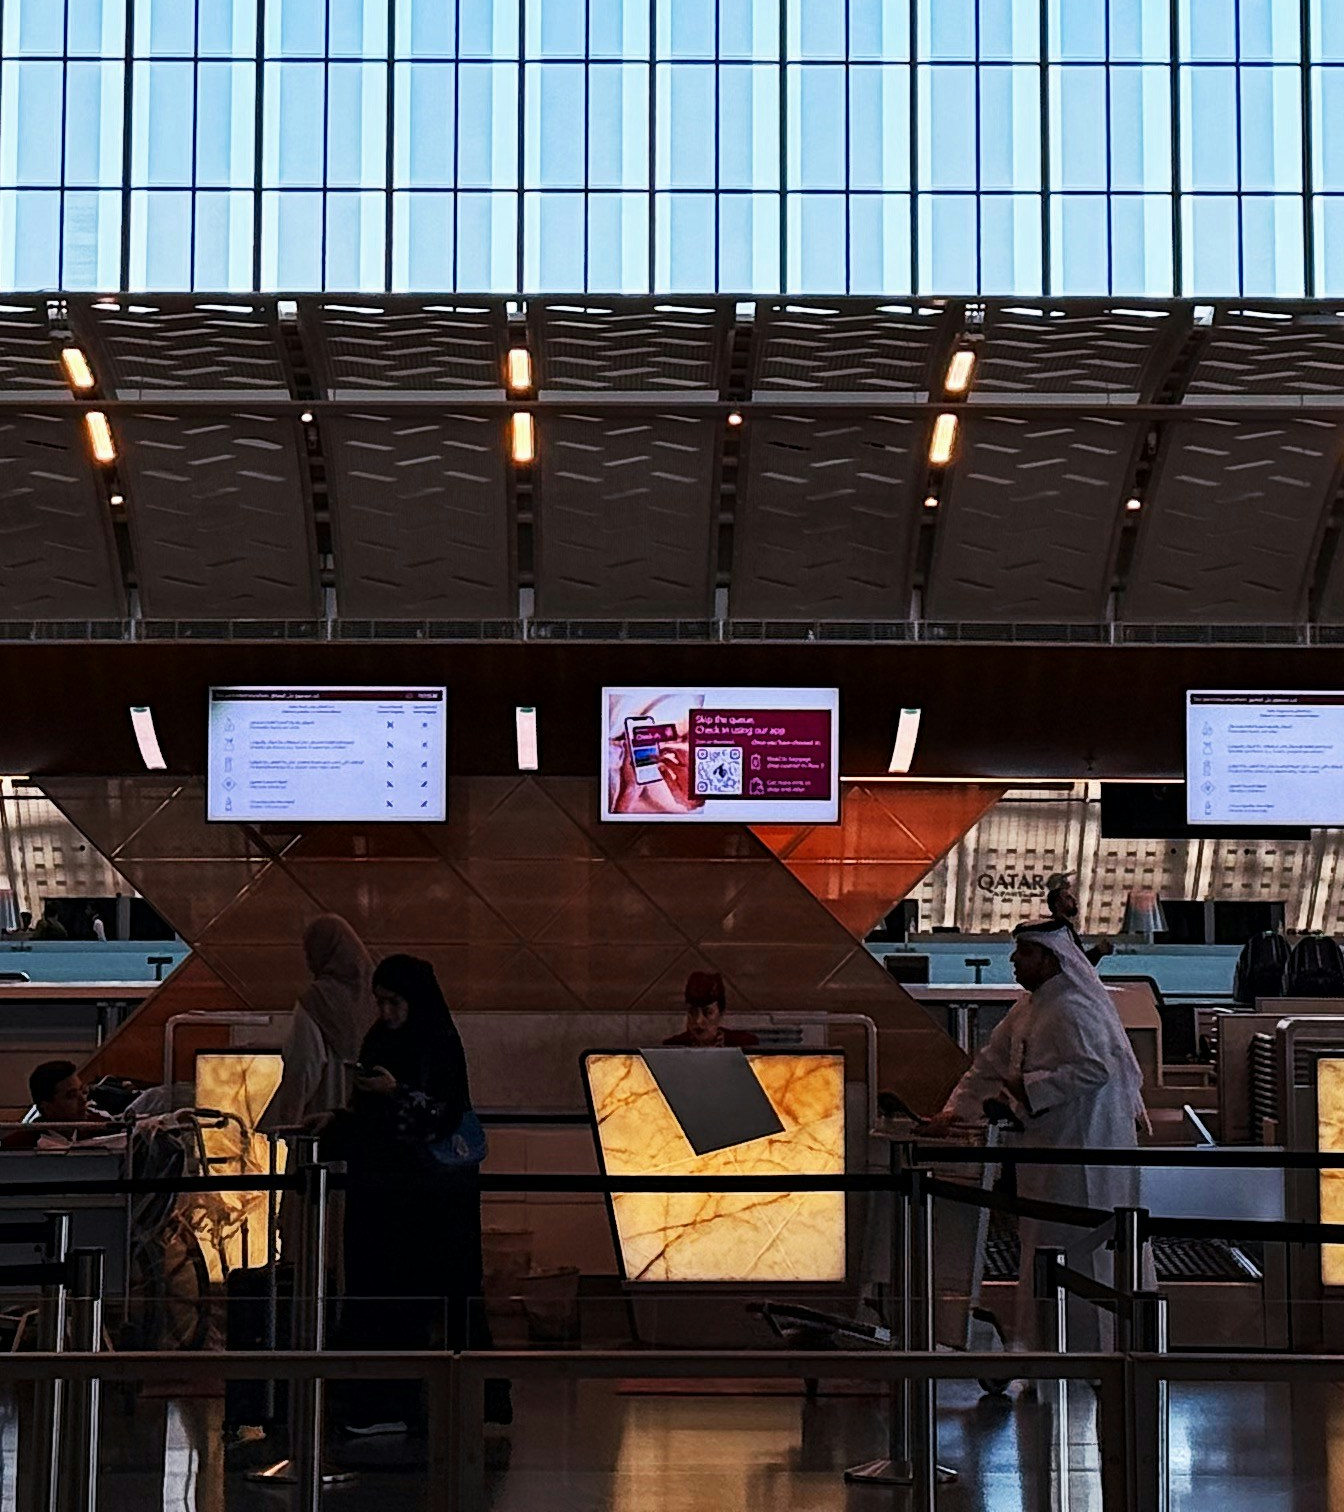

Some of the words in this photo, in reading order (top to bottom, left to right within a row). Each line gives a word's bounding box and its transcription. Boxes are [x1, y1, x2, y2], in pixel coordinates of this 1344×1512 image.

[695, 715, 713, 725] Skip
[715, 715, 727, 724] the
[695, 725, 720, 734] Check
[769, 727, 786, 735] app
[978, 873, 1044, 893] QATAR
